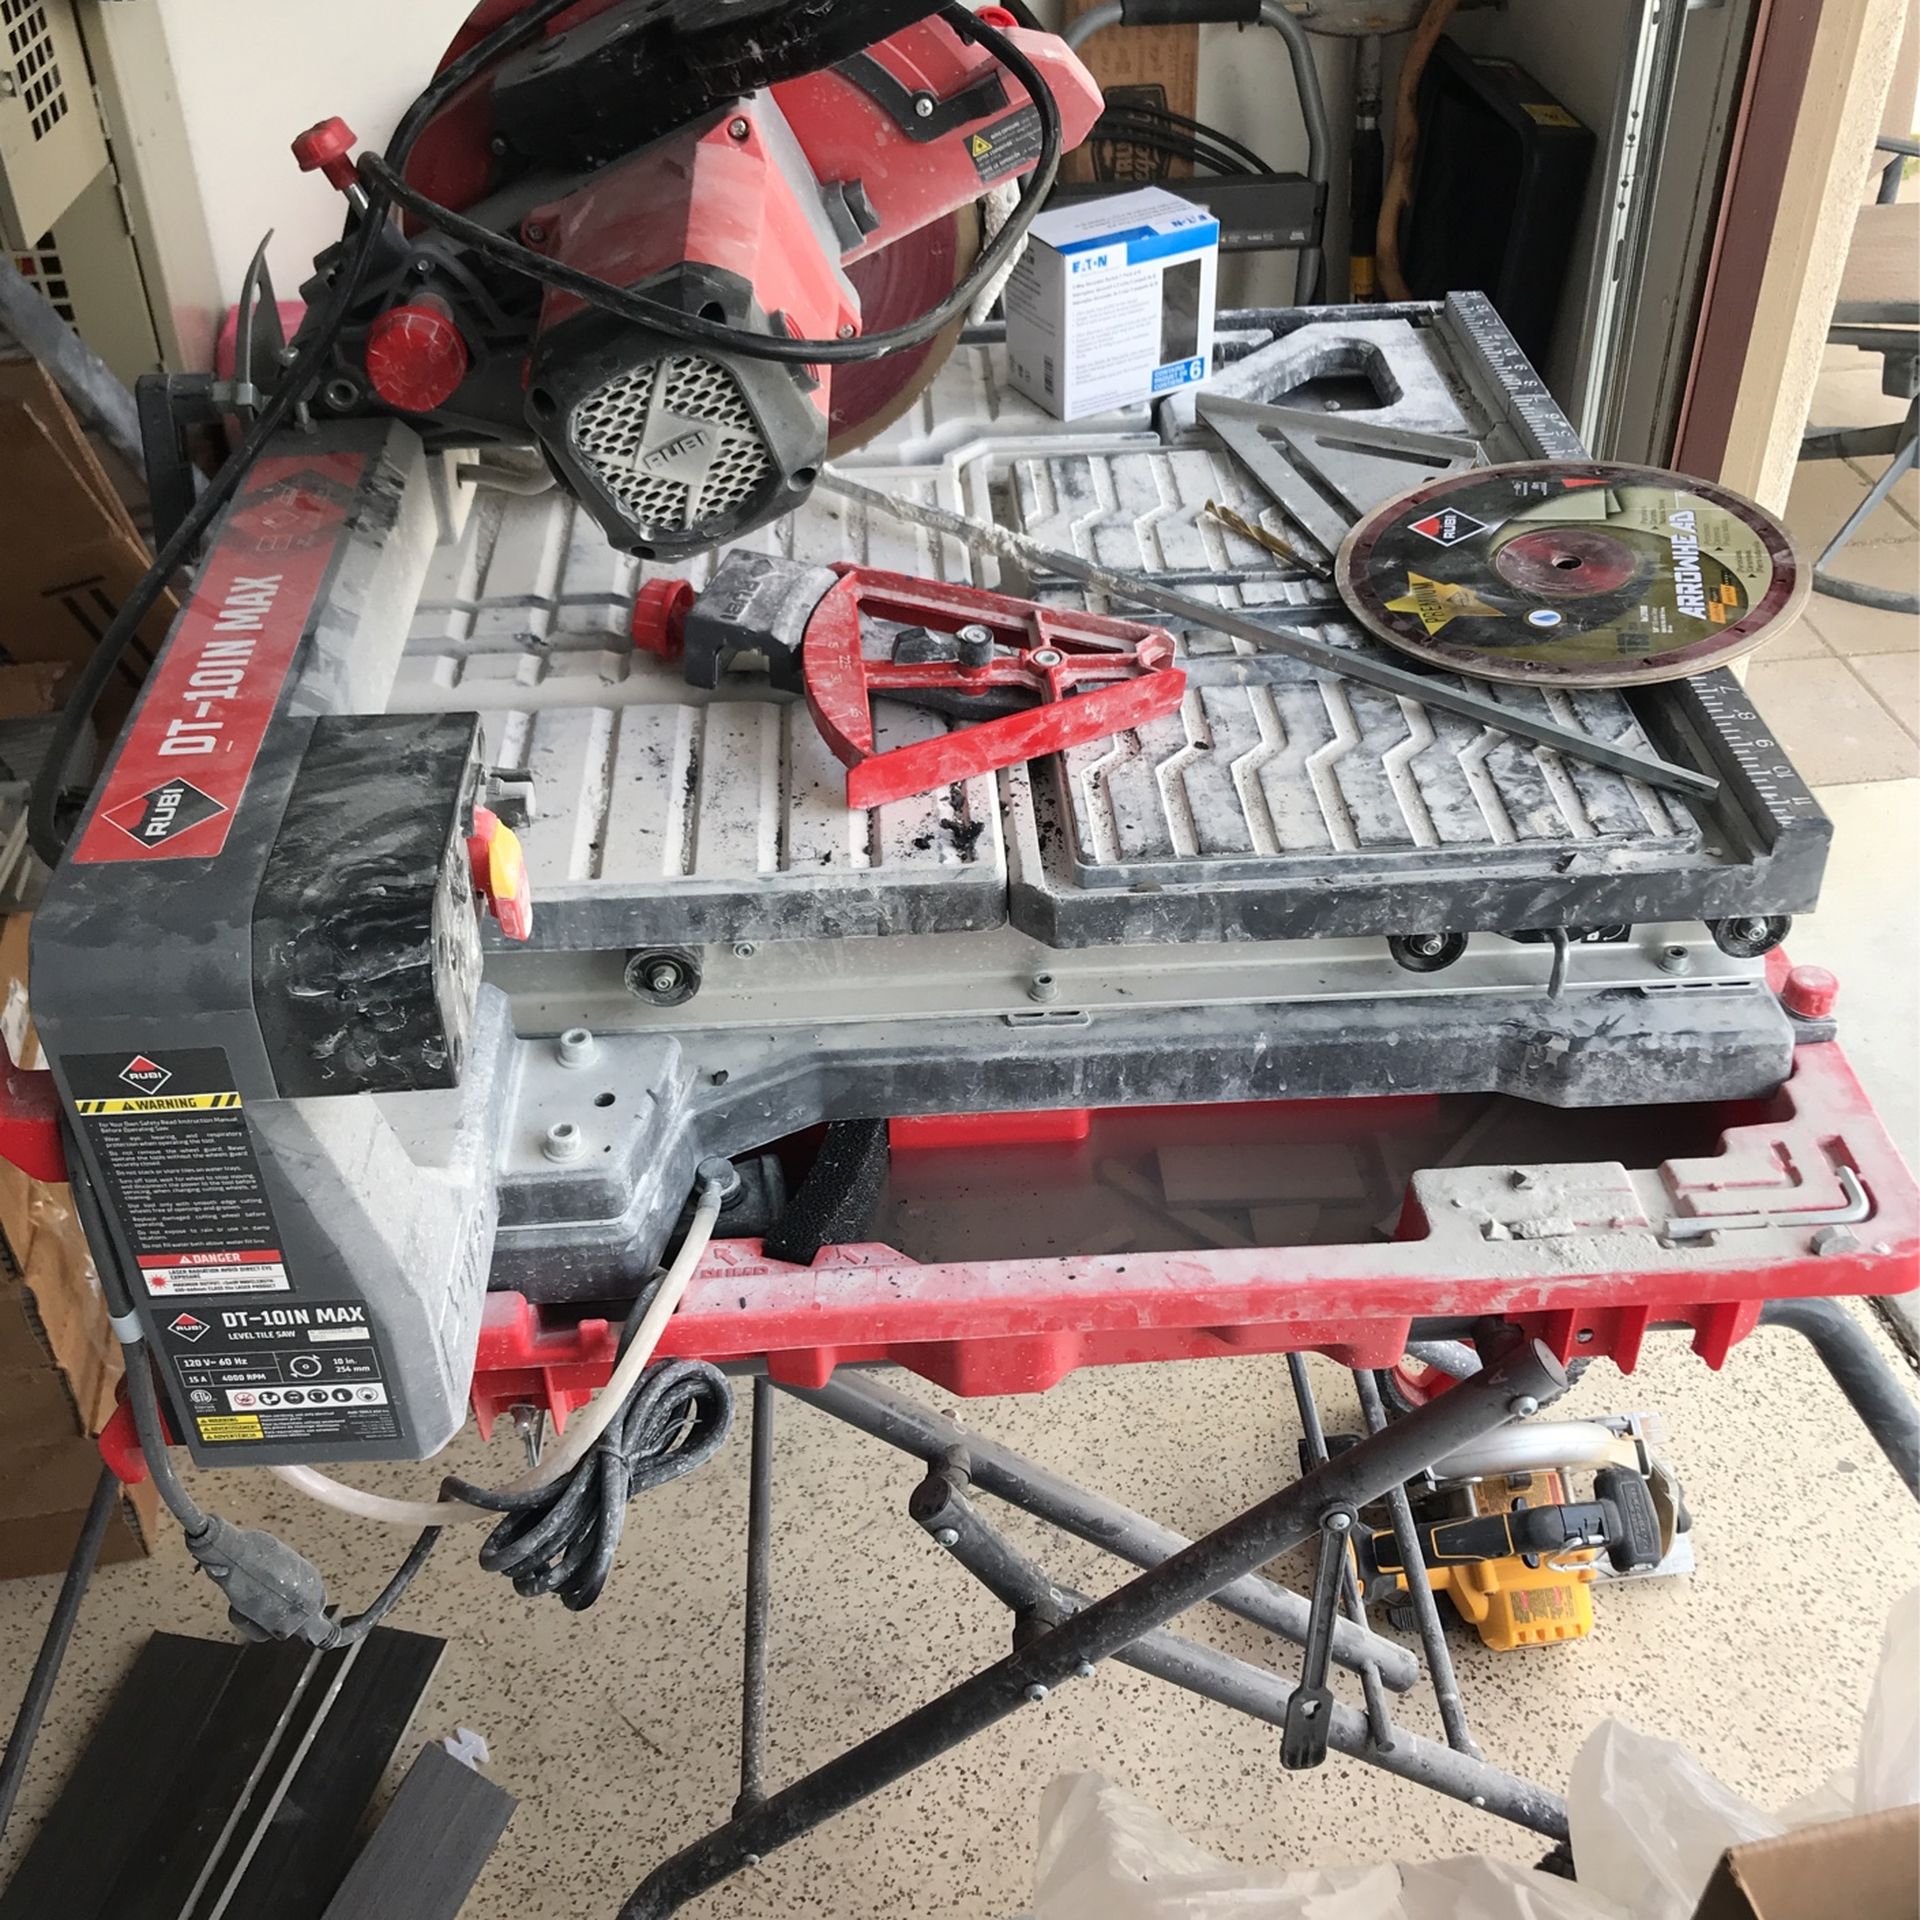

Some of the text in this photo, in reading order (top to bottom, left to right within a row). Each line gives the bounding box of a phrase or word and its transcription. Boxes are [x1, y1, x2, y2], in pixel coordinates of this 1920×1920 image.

[1189, 359, 1201, 379] 6
[644, 431, 711, 471] RUBI
[1443, 514, 1457, 539] RUBI
[1668, 510, 1708, 621] ARROWHEAD
[213, 573, 283, 632] MAX
[1412, 581, 1446, 624] PREMIUM
[1719, 686, 1739, 695] 7
[1737, 711, 1756, 721] 8
[1755, 738, 1775, 748] 9
[1772, 765, 1795, 779] 10
[145, 787, 184, 838] RUBI
[129, 1071, 163, 1081] RUBI
[135, 1097, 197, 1110] WARNING
[192, 1253, 242, 1264] DANGER
[222, 1306, 365, 1328] DT-10IN MAX
[228, 1330, 296, 1341] LEVEL TILE SAW
[184, 1359, 201, 1368] 120
[219, 1358, 232, 1366] 60
[235, 1357, 248, 1365] Hz
[188, 1375, 208, 1384] 15 A
[221, 1373, 267, 1382] 4000 RPM
